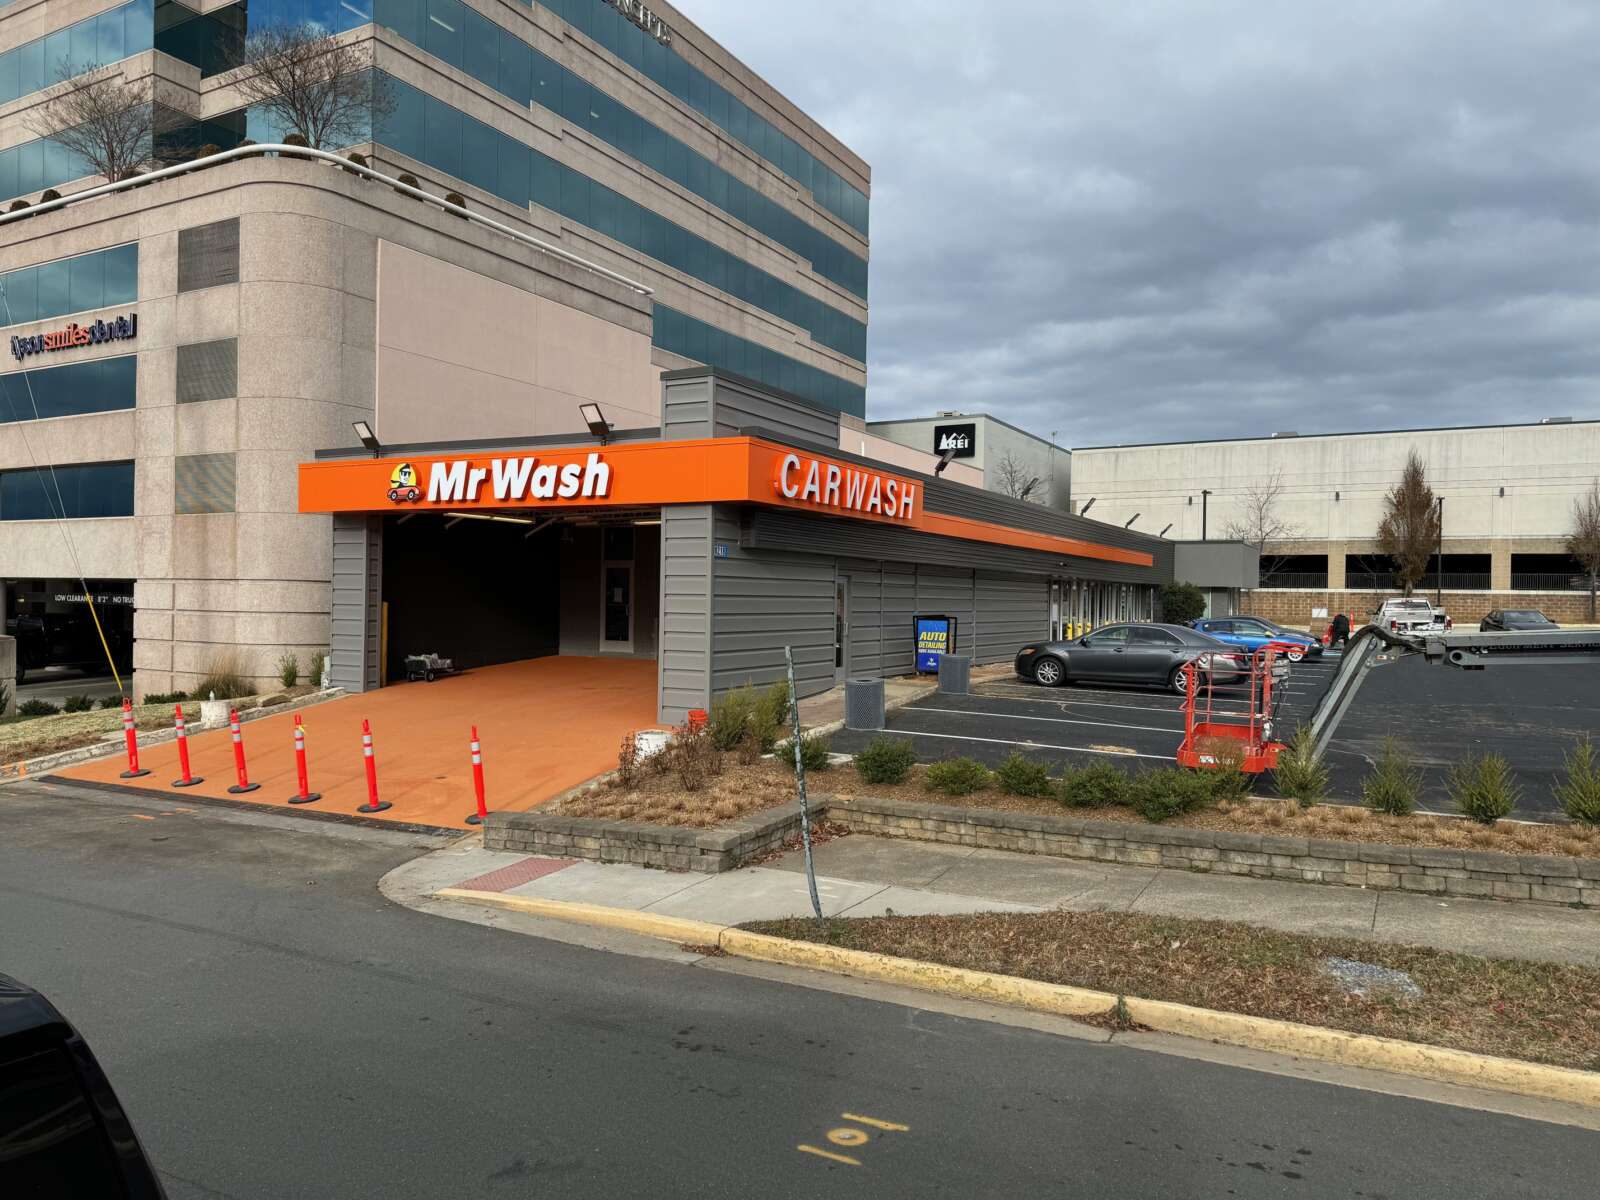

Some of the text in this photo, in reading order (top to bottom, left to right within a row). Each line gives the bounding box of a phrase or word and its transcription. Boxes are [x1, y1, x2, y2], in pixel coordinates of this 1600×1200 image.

[427, 453, 612, 502] Mr Wash
[920, 632, 947, 641] AUTO
[918, 641, 947, 649] DETAILING
